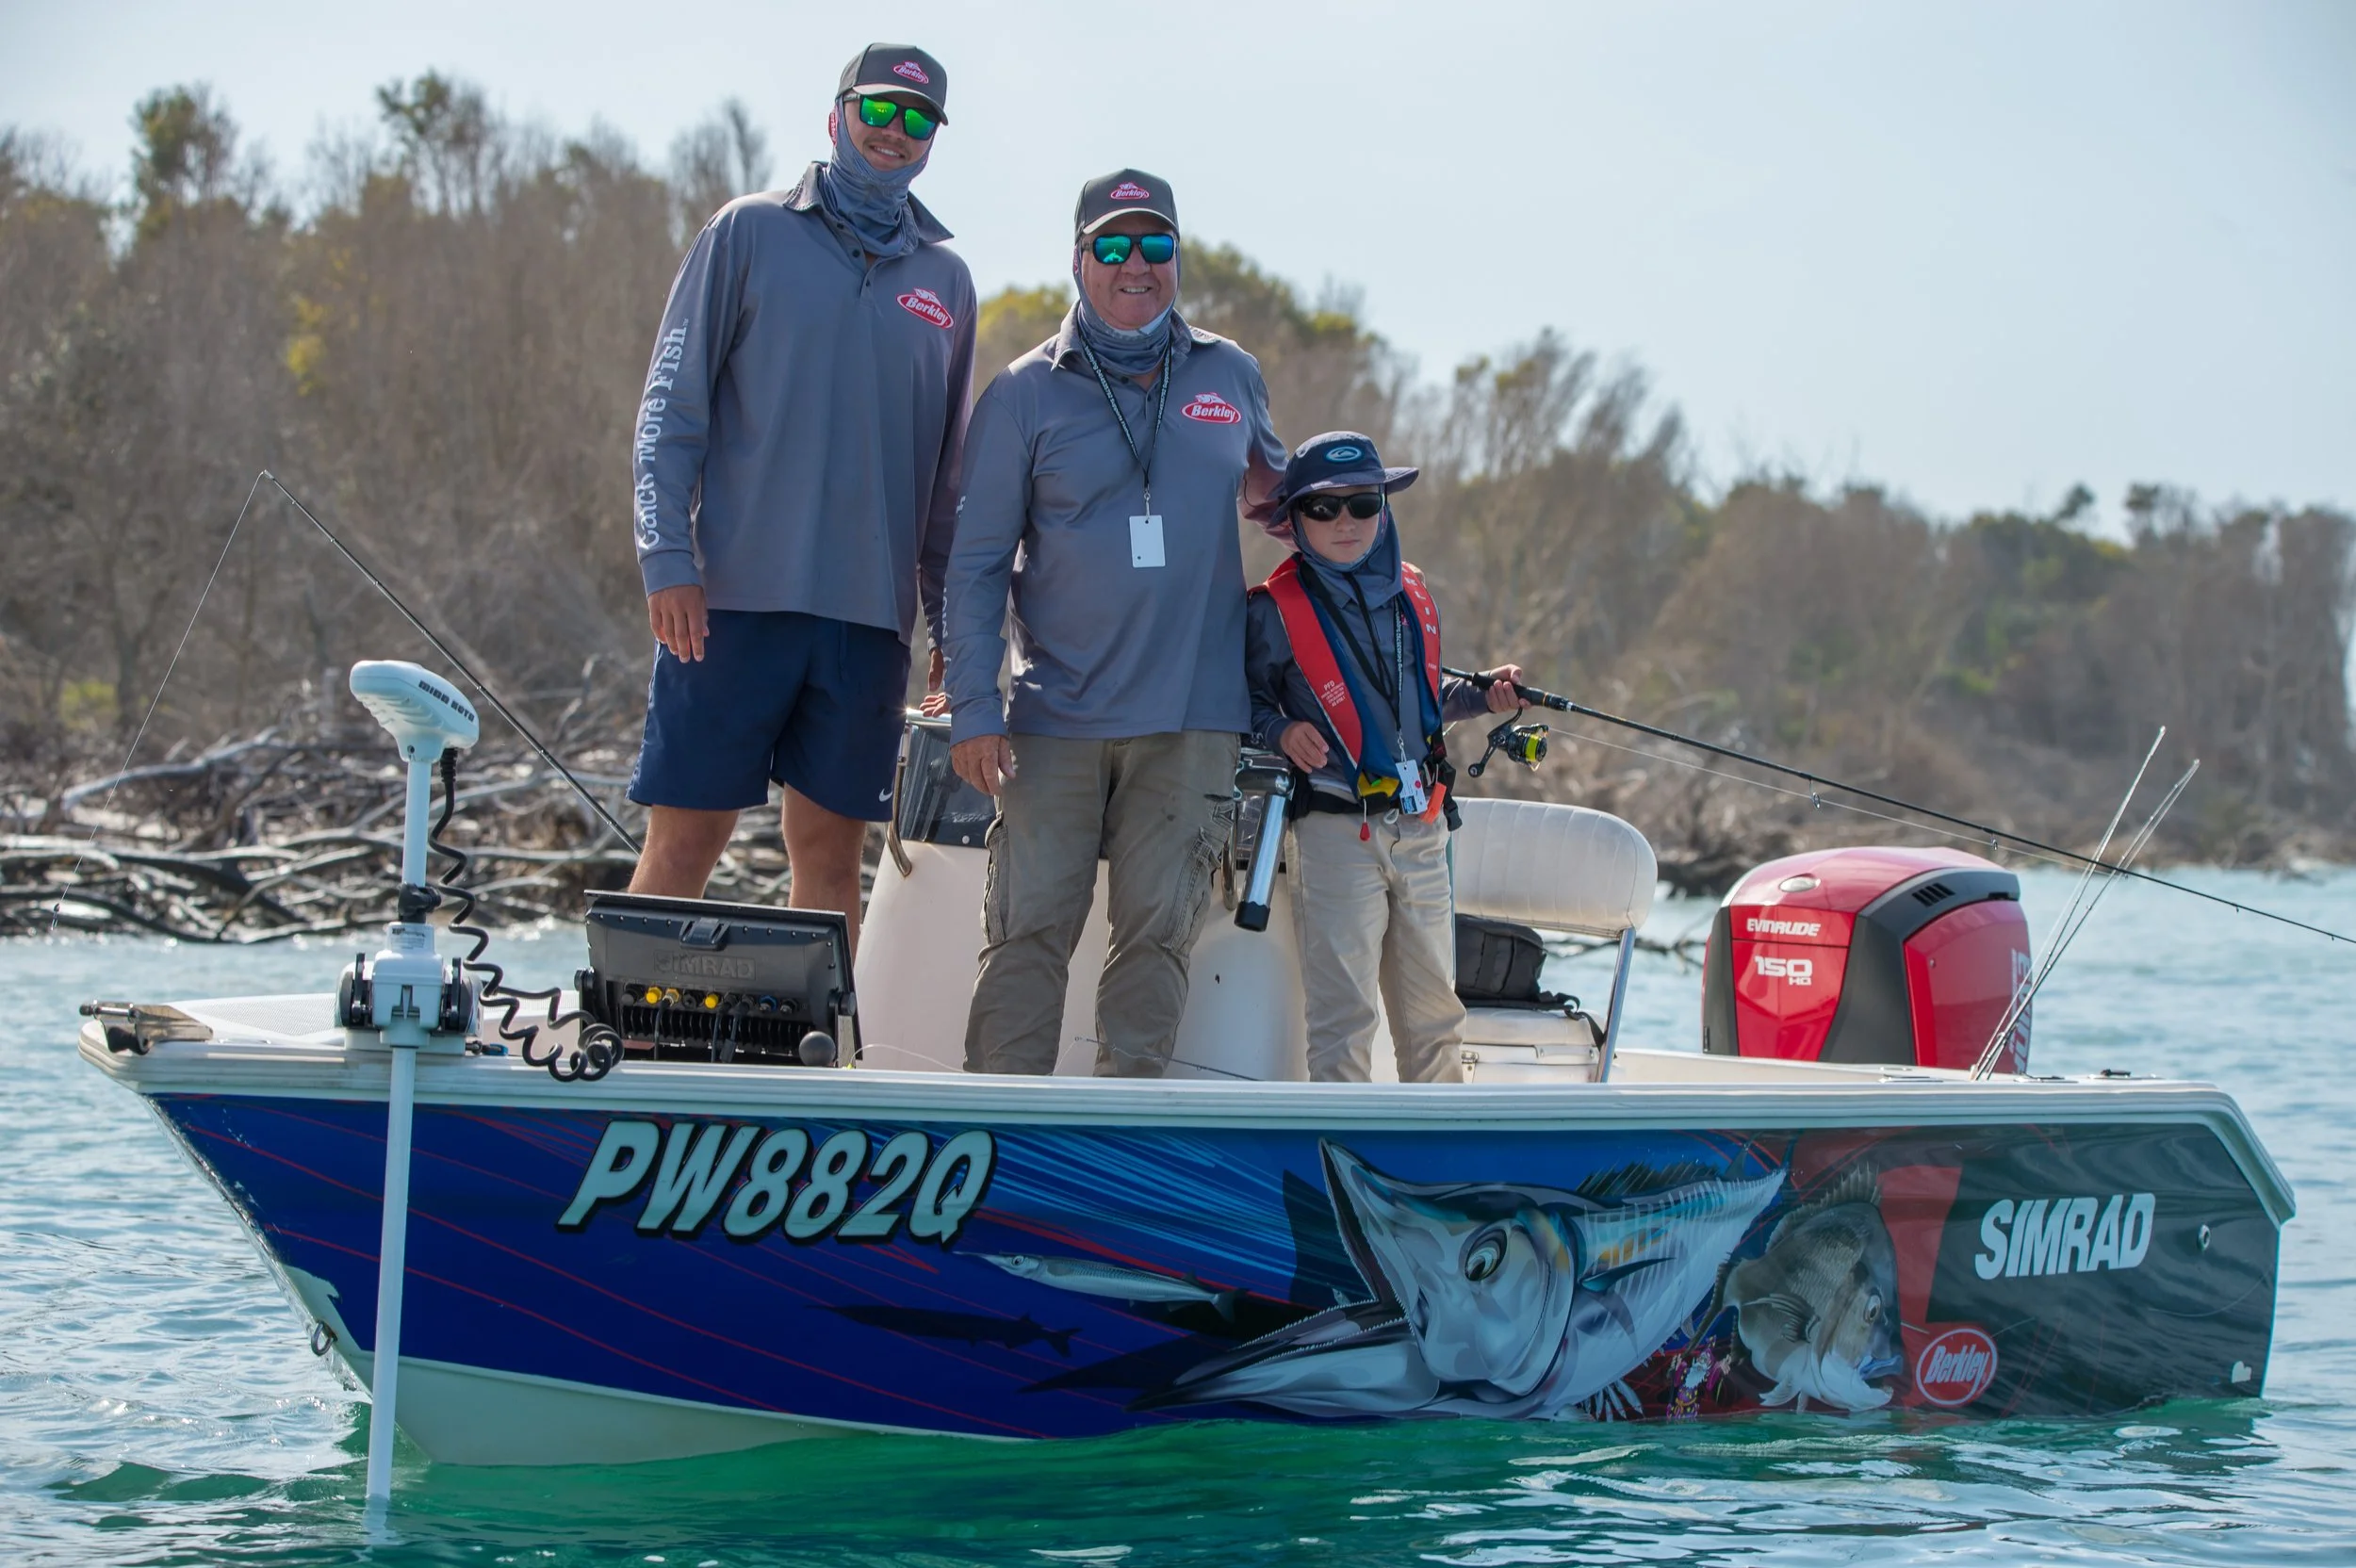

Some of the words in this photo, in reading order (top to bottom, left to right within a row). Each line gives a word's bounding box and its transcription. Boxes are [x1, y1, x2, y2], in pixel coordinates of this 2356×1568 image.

[897, 65, 926, 83] Berkley
[1115, 189, 1147, 199] Berkley
[906, 297, 949, 326] Berkley
[1191, 404, 1236, 423] Berkley
[637, 397, 666, 465] More
[1746, 918, 1821, 937] EVINRUDE
[654, 950, 755, 980] SIMRAD
[1754, 956, 1812, 977] 150
[554, 1119, 997, 1250] PW882Q
[1974, 1192, 2156, 1281] SIMRAD
[1923, 1343, 1991, 1395] Berkley
